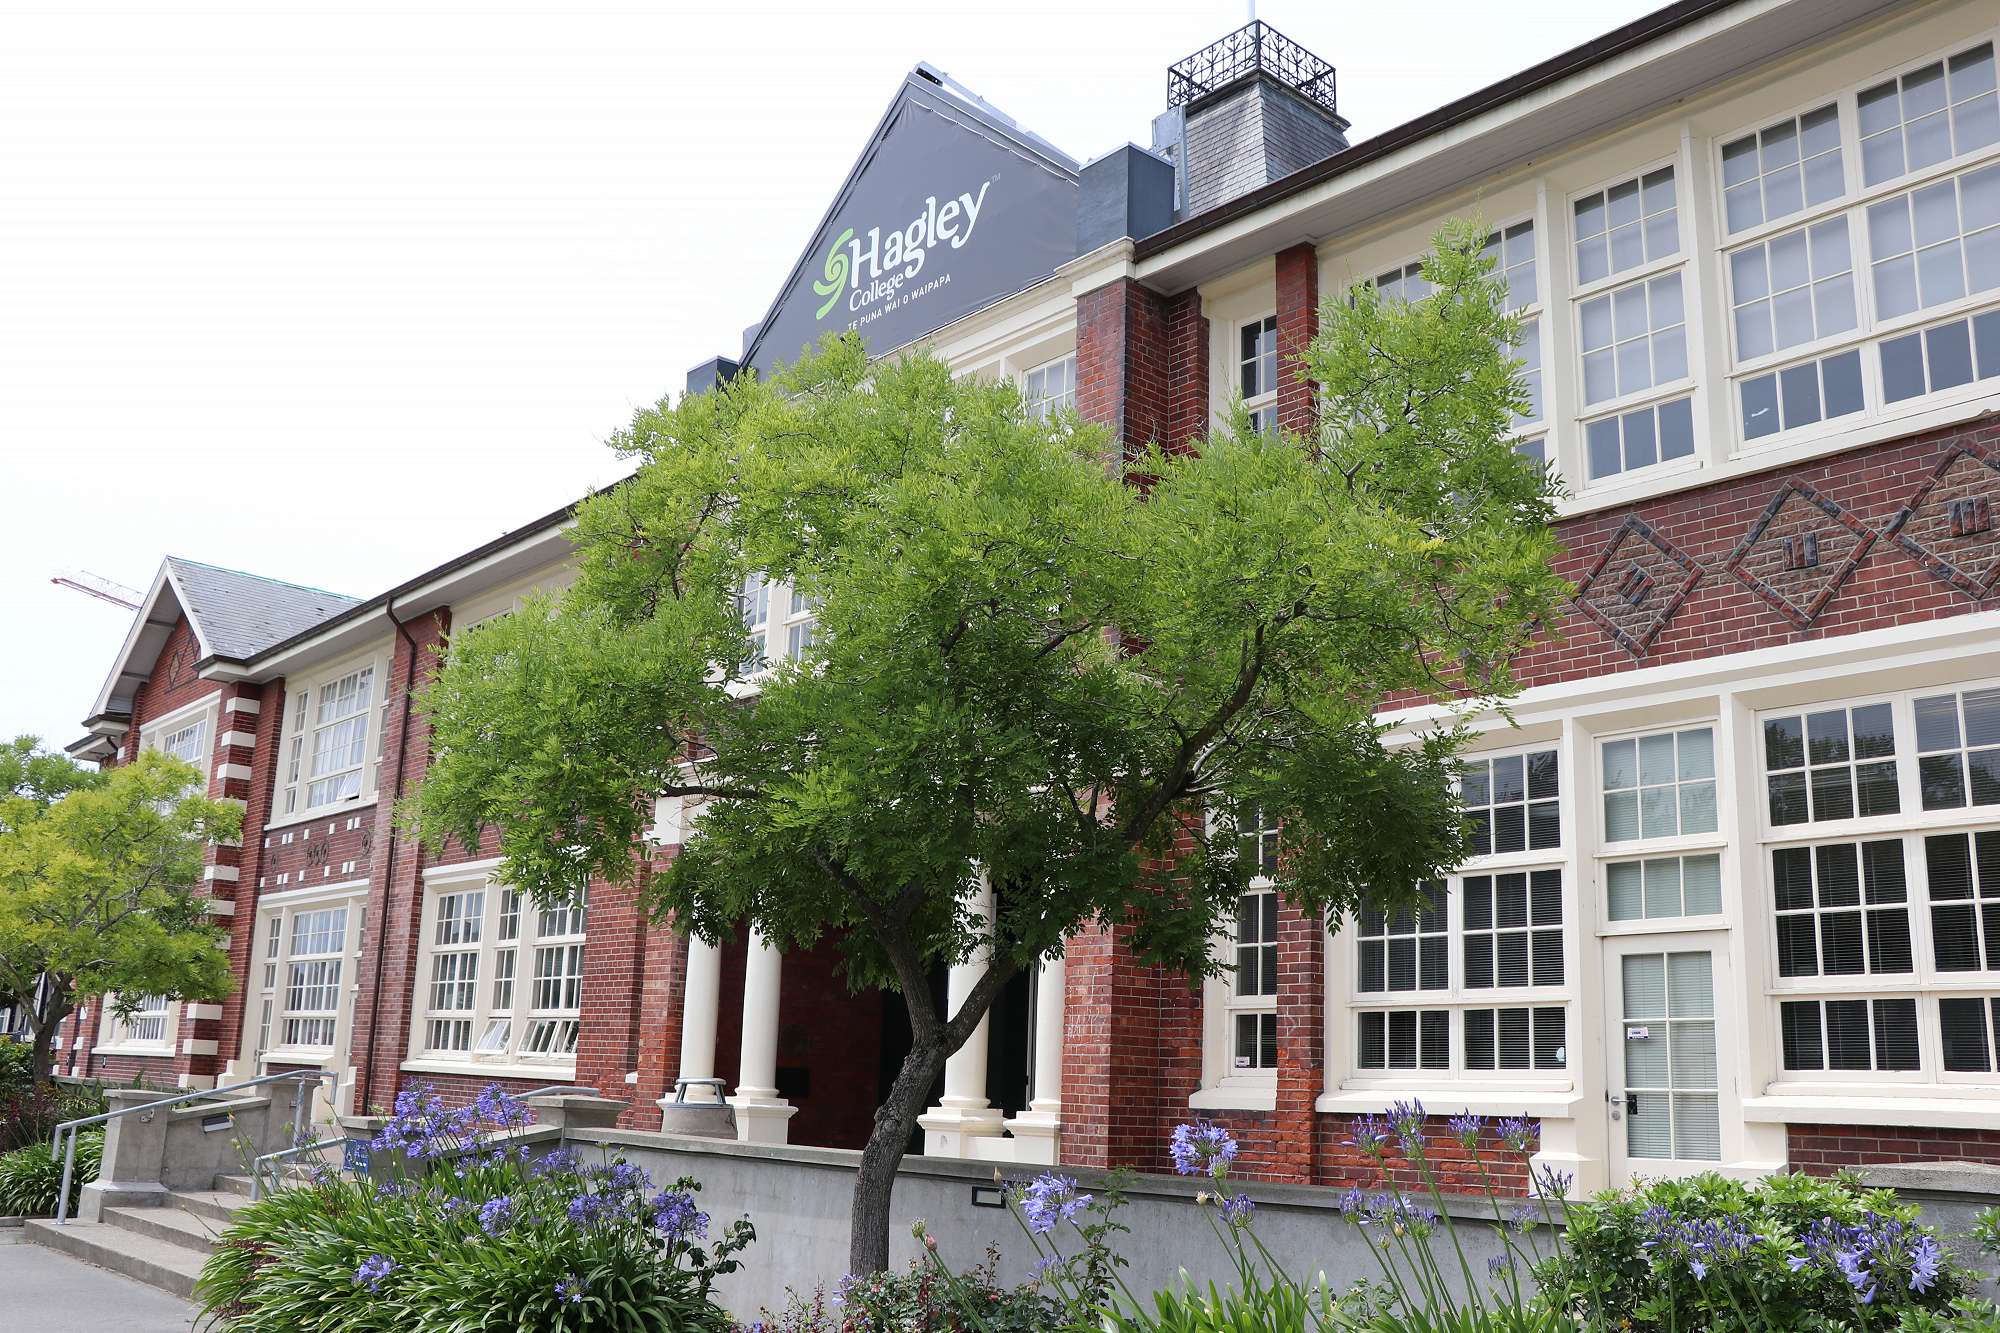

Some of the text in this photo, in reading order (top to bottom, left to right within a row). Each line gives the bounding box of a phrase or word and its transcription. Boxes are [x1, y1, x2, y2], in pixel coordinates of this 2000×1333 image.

[849, 181, 990, 288] Hagley
[849, 273, 904, 312] College
[860, 307, 882, 326] PUNA
[884, 298, 900, 314] WAI
[903, 295, 909, 304] O
[911, 273, 951, 301] WAIPAPA
